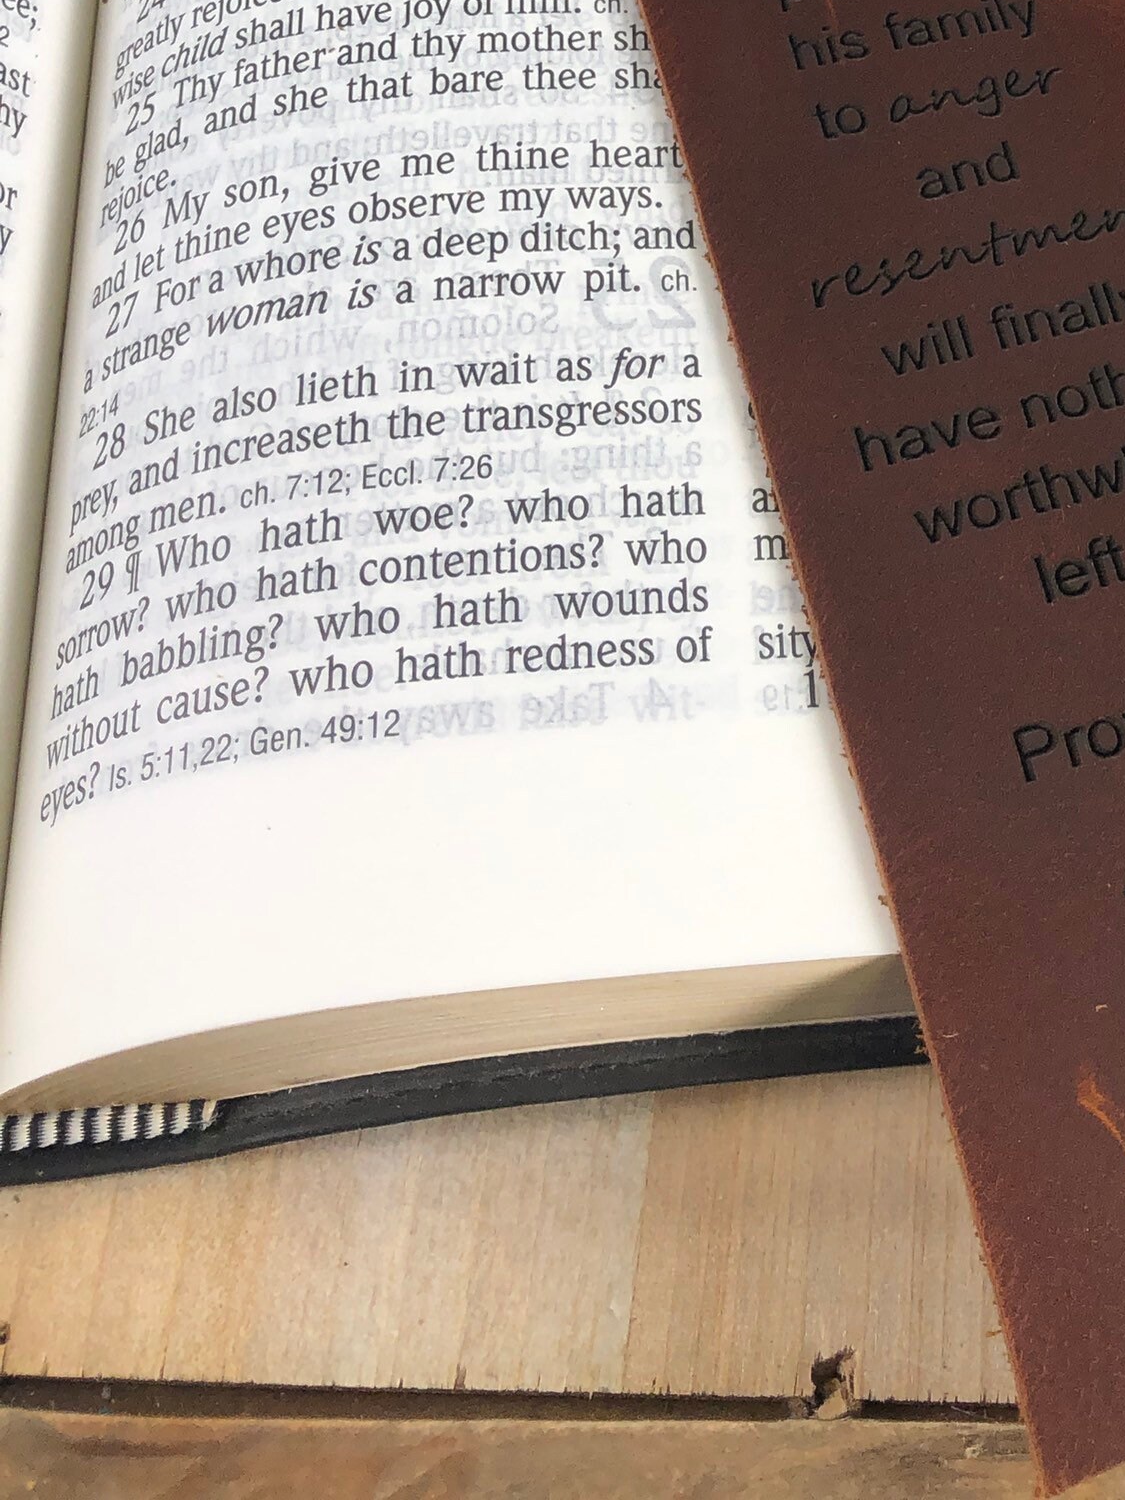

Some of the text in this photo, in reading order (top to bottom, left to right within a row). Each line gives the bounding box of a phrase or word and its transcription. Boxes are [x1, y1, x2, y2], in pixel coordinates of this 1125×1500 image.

[314, 1, 393, 33] have
[787, 25, 872, 71] his
[428, 61, 597, 96] bare thee
[812, 65, 1063, 140] to anger
[914, 140, 1020, 200] and
[348, 187, 664, 225] observe my ways.
[347, 261, 699, 311] is a narrow pit. ch.
[880, 314, 975, 377] will
[212, 346, 703, 424] also lieth in wait as for a
[386, 398, 703, 440] the transgressors
[852, 405, 1001, 473] have
[240, 453, 493, 509] ch. 7:12; Eccl. 7:26
[372, 481, 706, 536] woe? who hath
[358, 529, 707, 587] contentions? who
[120, 577, 709, 688] babbling? who hath wounds
[504, 625, 714, 675] redness of
[40, 761, 101, 828] eyes?
[250, 726, 310, 756] Gen.
[320, 709, 401, 744] 49:12
